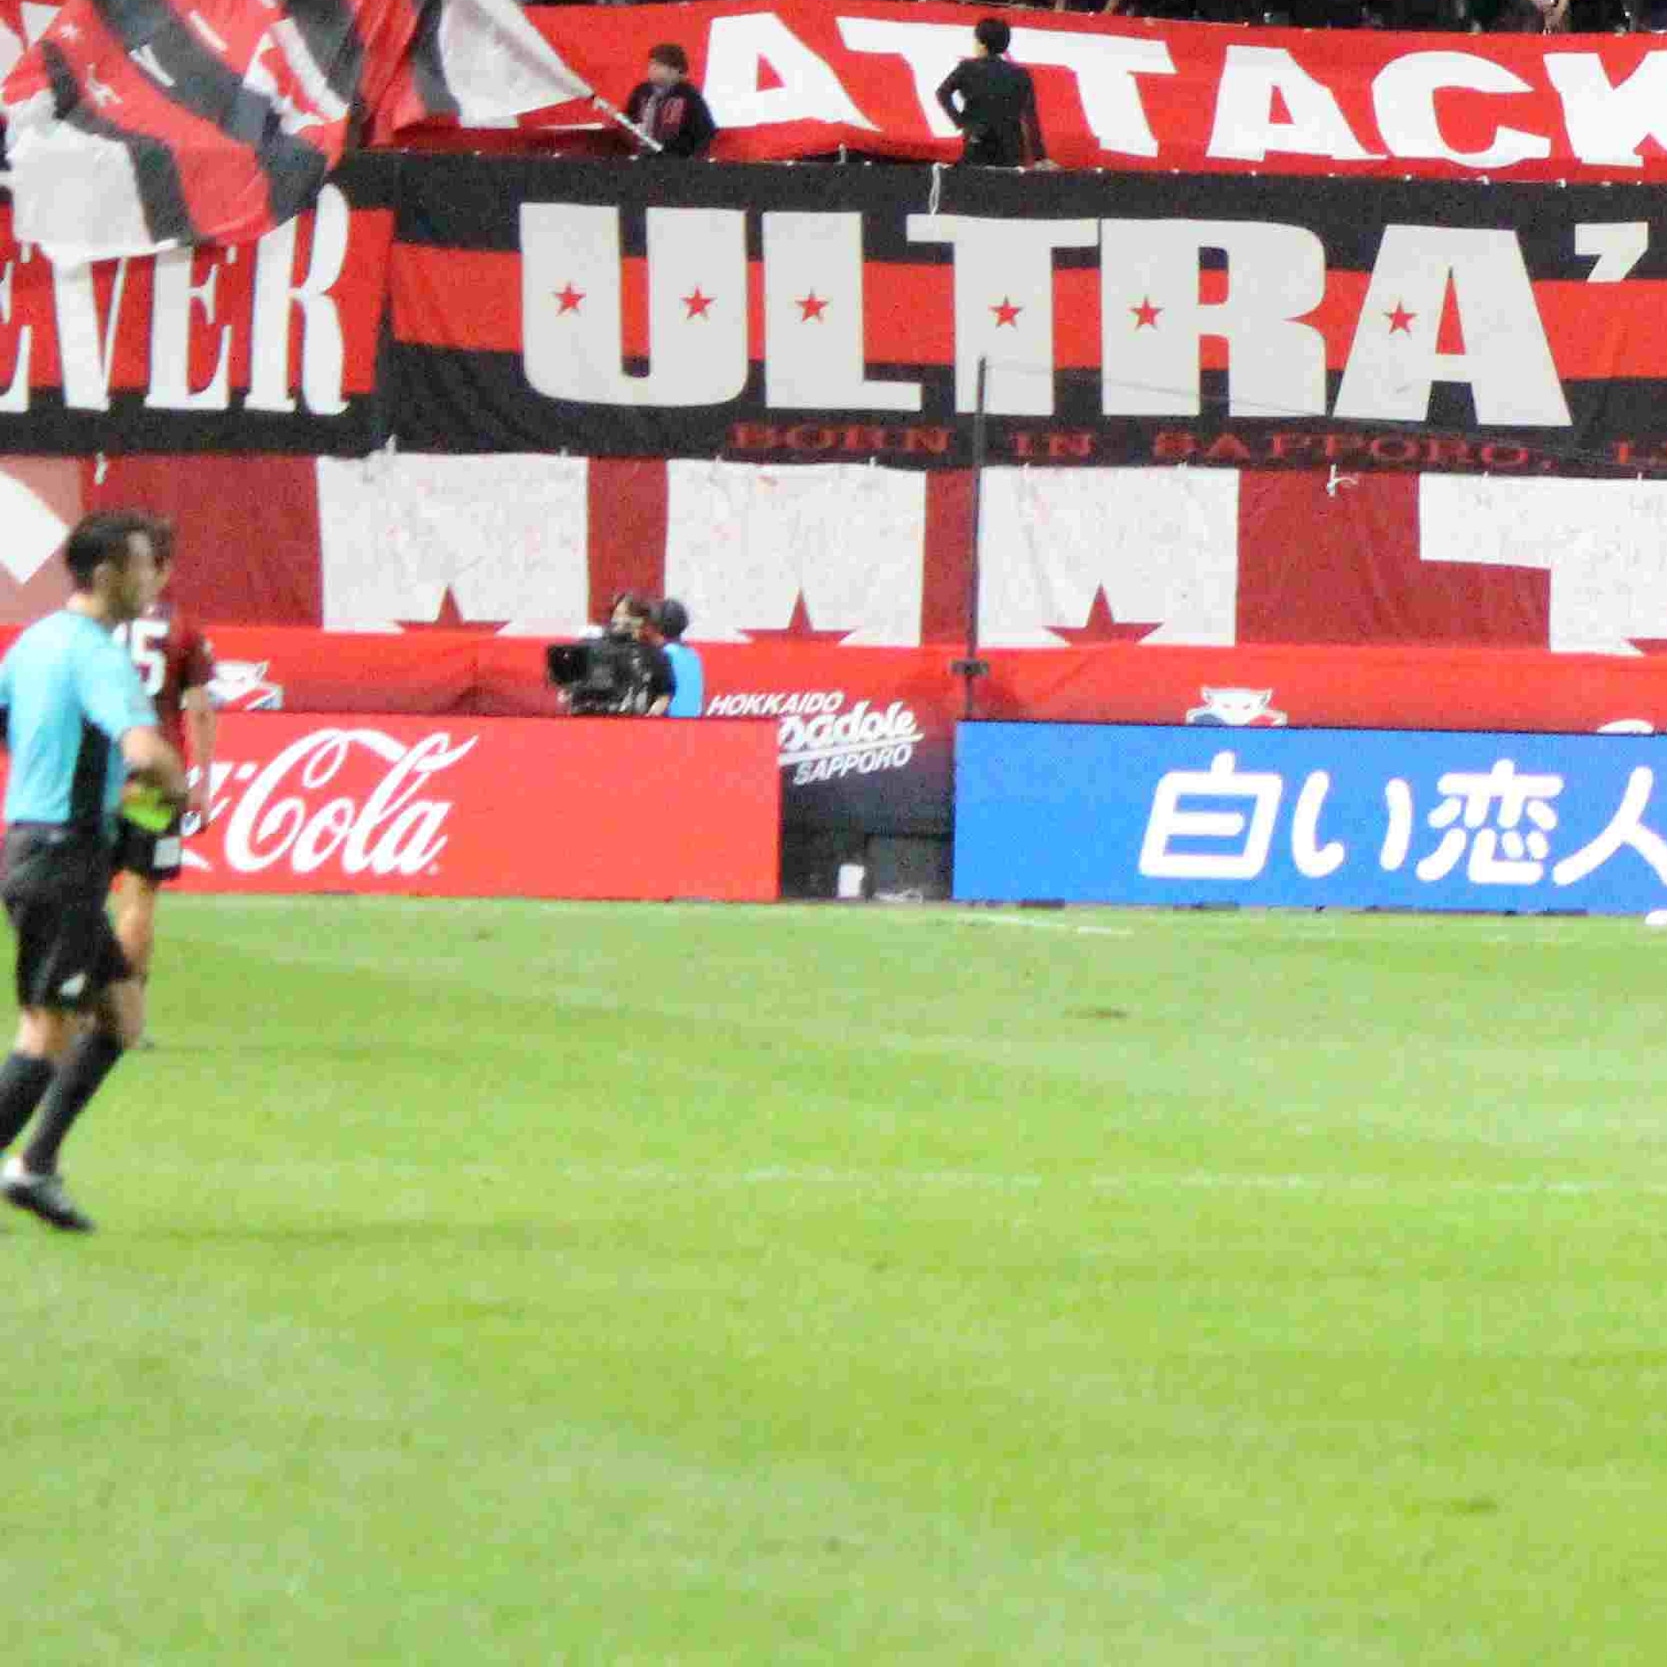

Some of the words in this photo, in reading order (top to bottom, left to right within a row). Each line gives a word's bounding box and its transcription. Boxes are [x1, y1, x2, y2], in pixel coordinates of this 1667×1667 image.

[726, 422, 952, 457] BORN
[1011, 430, 1094, 460] IN
[706, 689, 845, 717] HOKKAIDO
[792, 741, 912, 785] SAPPORO
